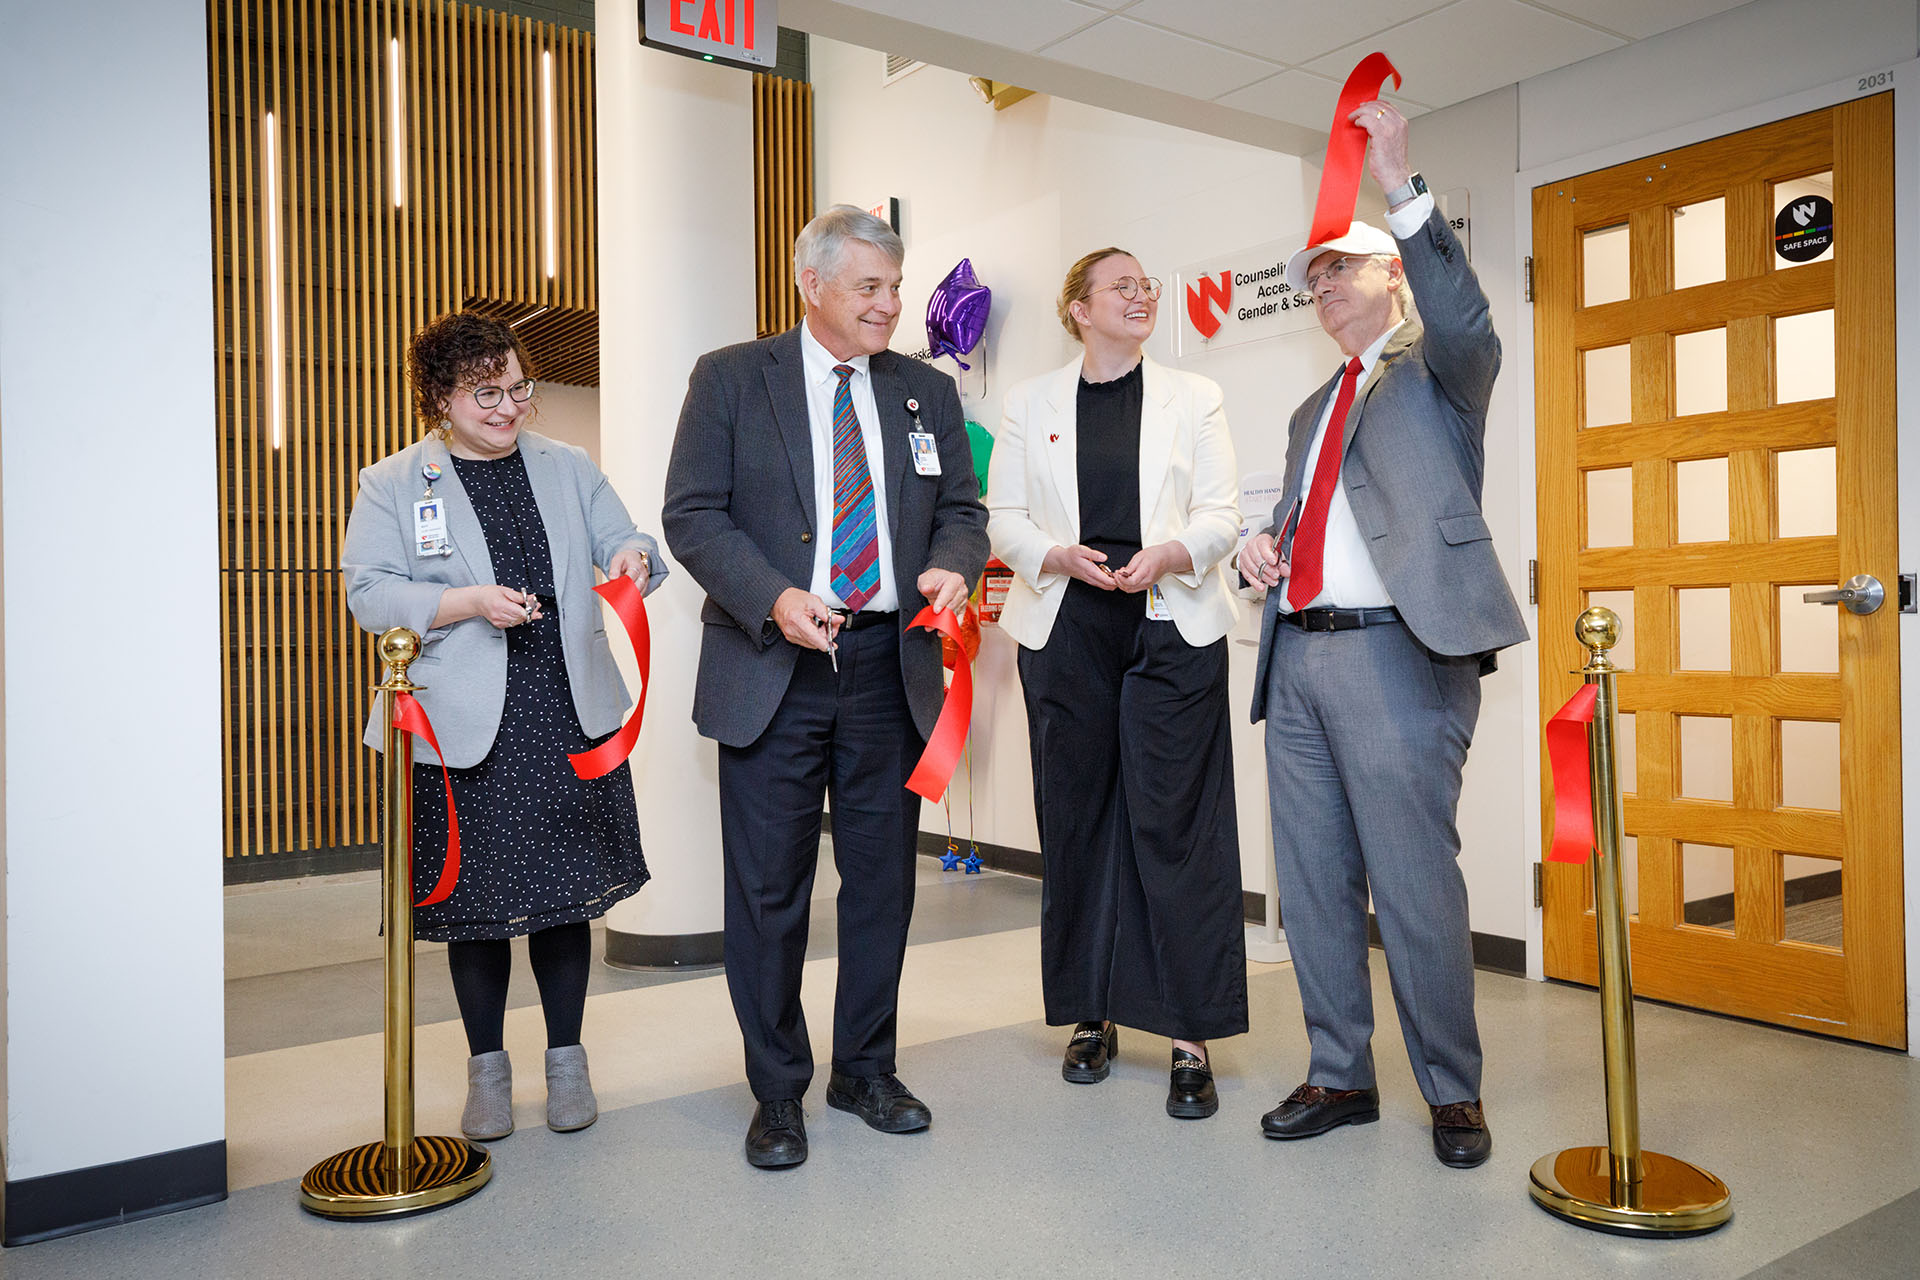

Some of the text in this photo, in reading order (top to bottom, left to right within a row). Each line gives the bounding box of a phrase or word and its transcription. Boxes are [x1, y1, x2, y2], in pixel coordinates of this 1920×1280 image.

[1858, 70, 1894, 91] 2031
[1783, 235, 1827, 251] SAFE SPACE
[1238, 302, 1278, 320] Gender
[1281, 297, 1290, 311] &
